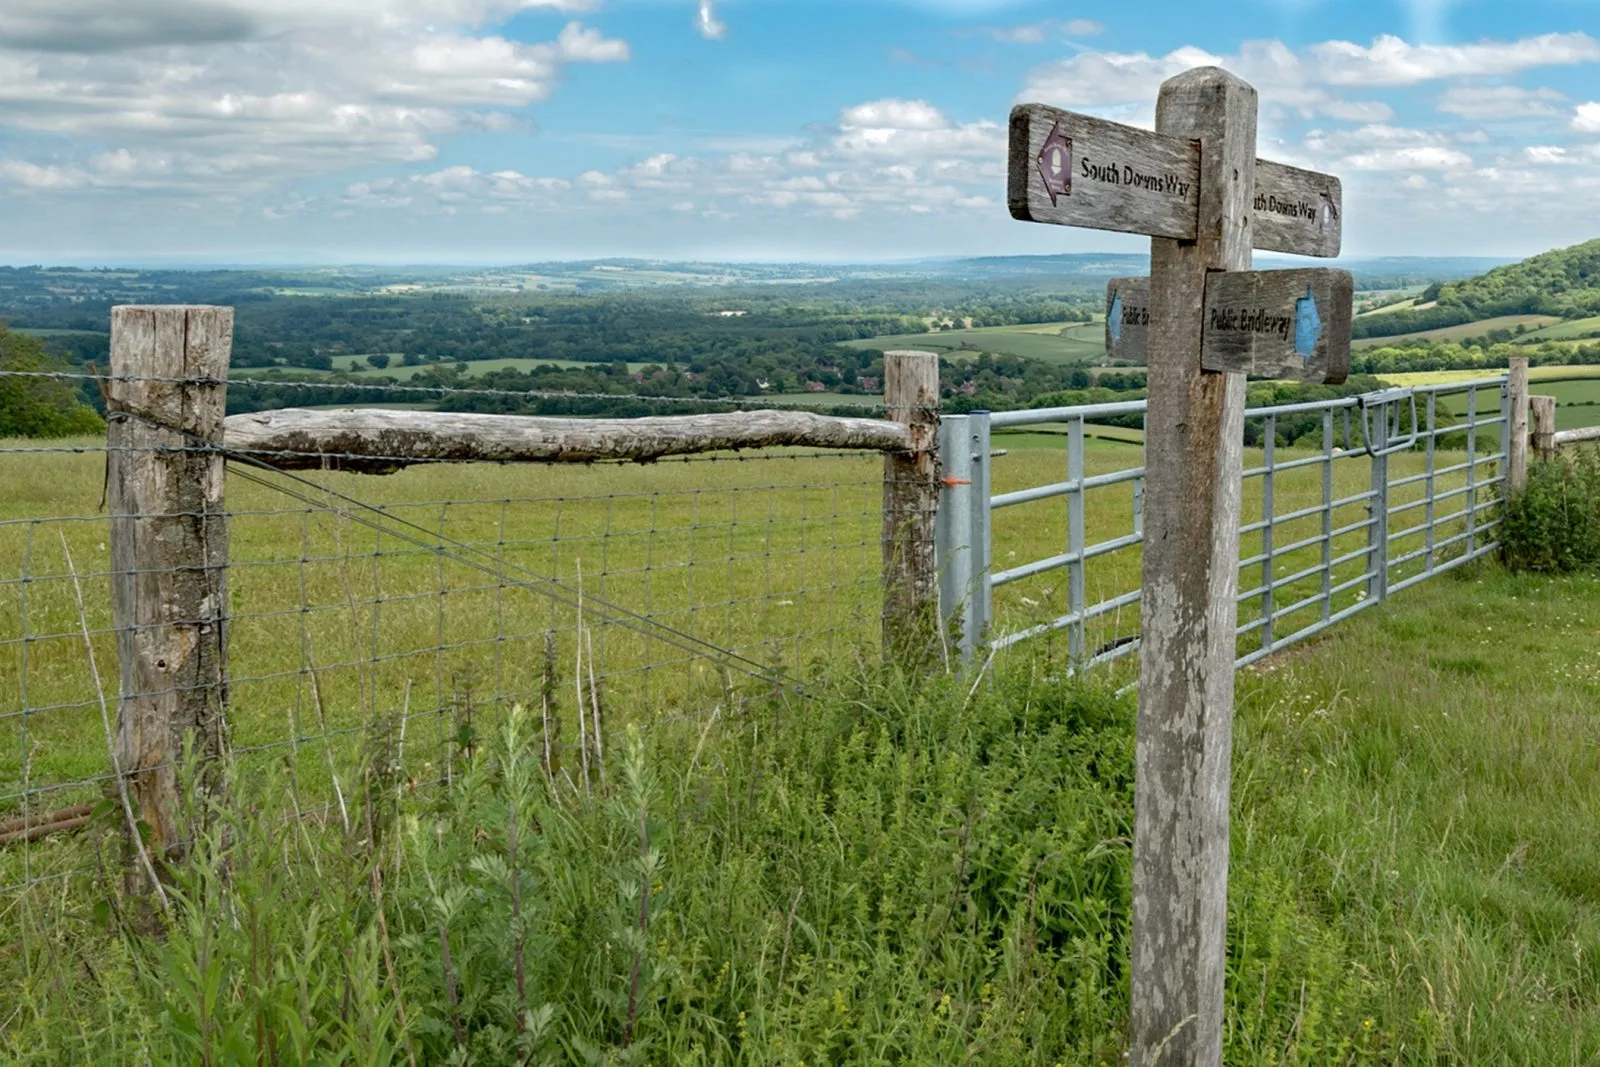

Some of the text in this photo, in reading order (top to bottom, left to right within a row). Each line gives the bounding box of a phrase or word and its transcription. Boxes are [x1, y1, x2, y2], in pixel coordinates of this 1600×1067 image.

[1081, 157, 1119, 184] South
[1123, 165, 1163, 192] Downs
[1164, 173, 1190, 202] Way
[1268, 195, 1297, 217] Downs
[1298, 200, 1316, 224] Way
[1211, 308, 1237, 331] Public
